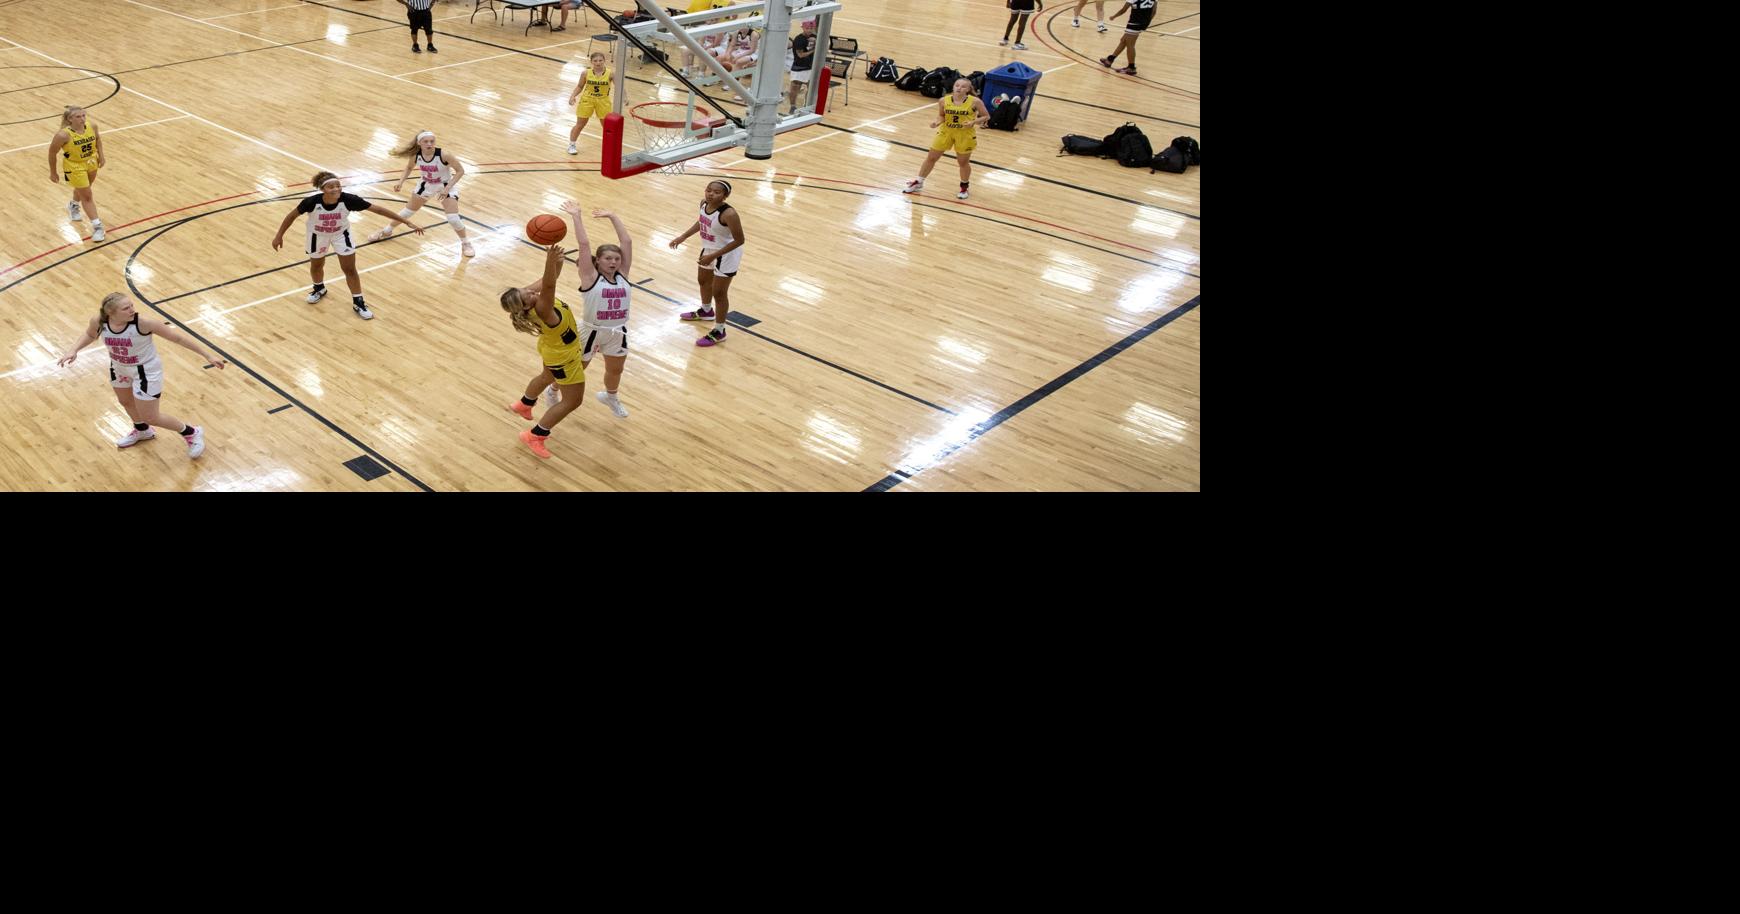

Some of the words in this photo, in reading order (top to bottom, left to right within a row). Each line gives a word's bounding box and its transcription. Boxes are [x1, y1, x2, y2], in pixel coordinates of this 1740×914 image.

[593, 85, 600, 93] 5
[952, 115, 960, 123] 2
[81, 142, 92, 153] 25
[601, 287, 627, 299] OMAHA
[607, 298, 621, 310] 10
[596, 309, 629, 321] SUPREME
[104, 336, 133, 348] OMAHA
